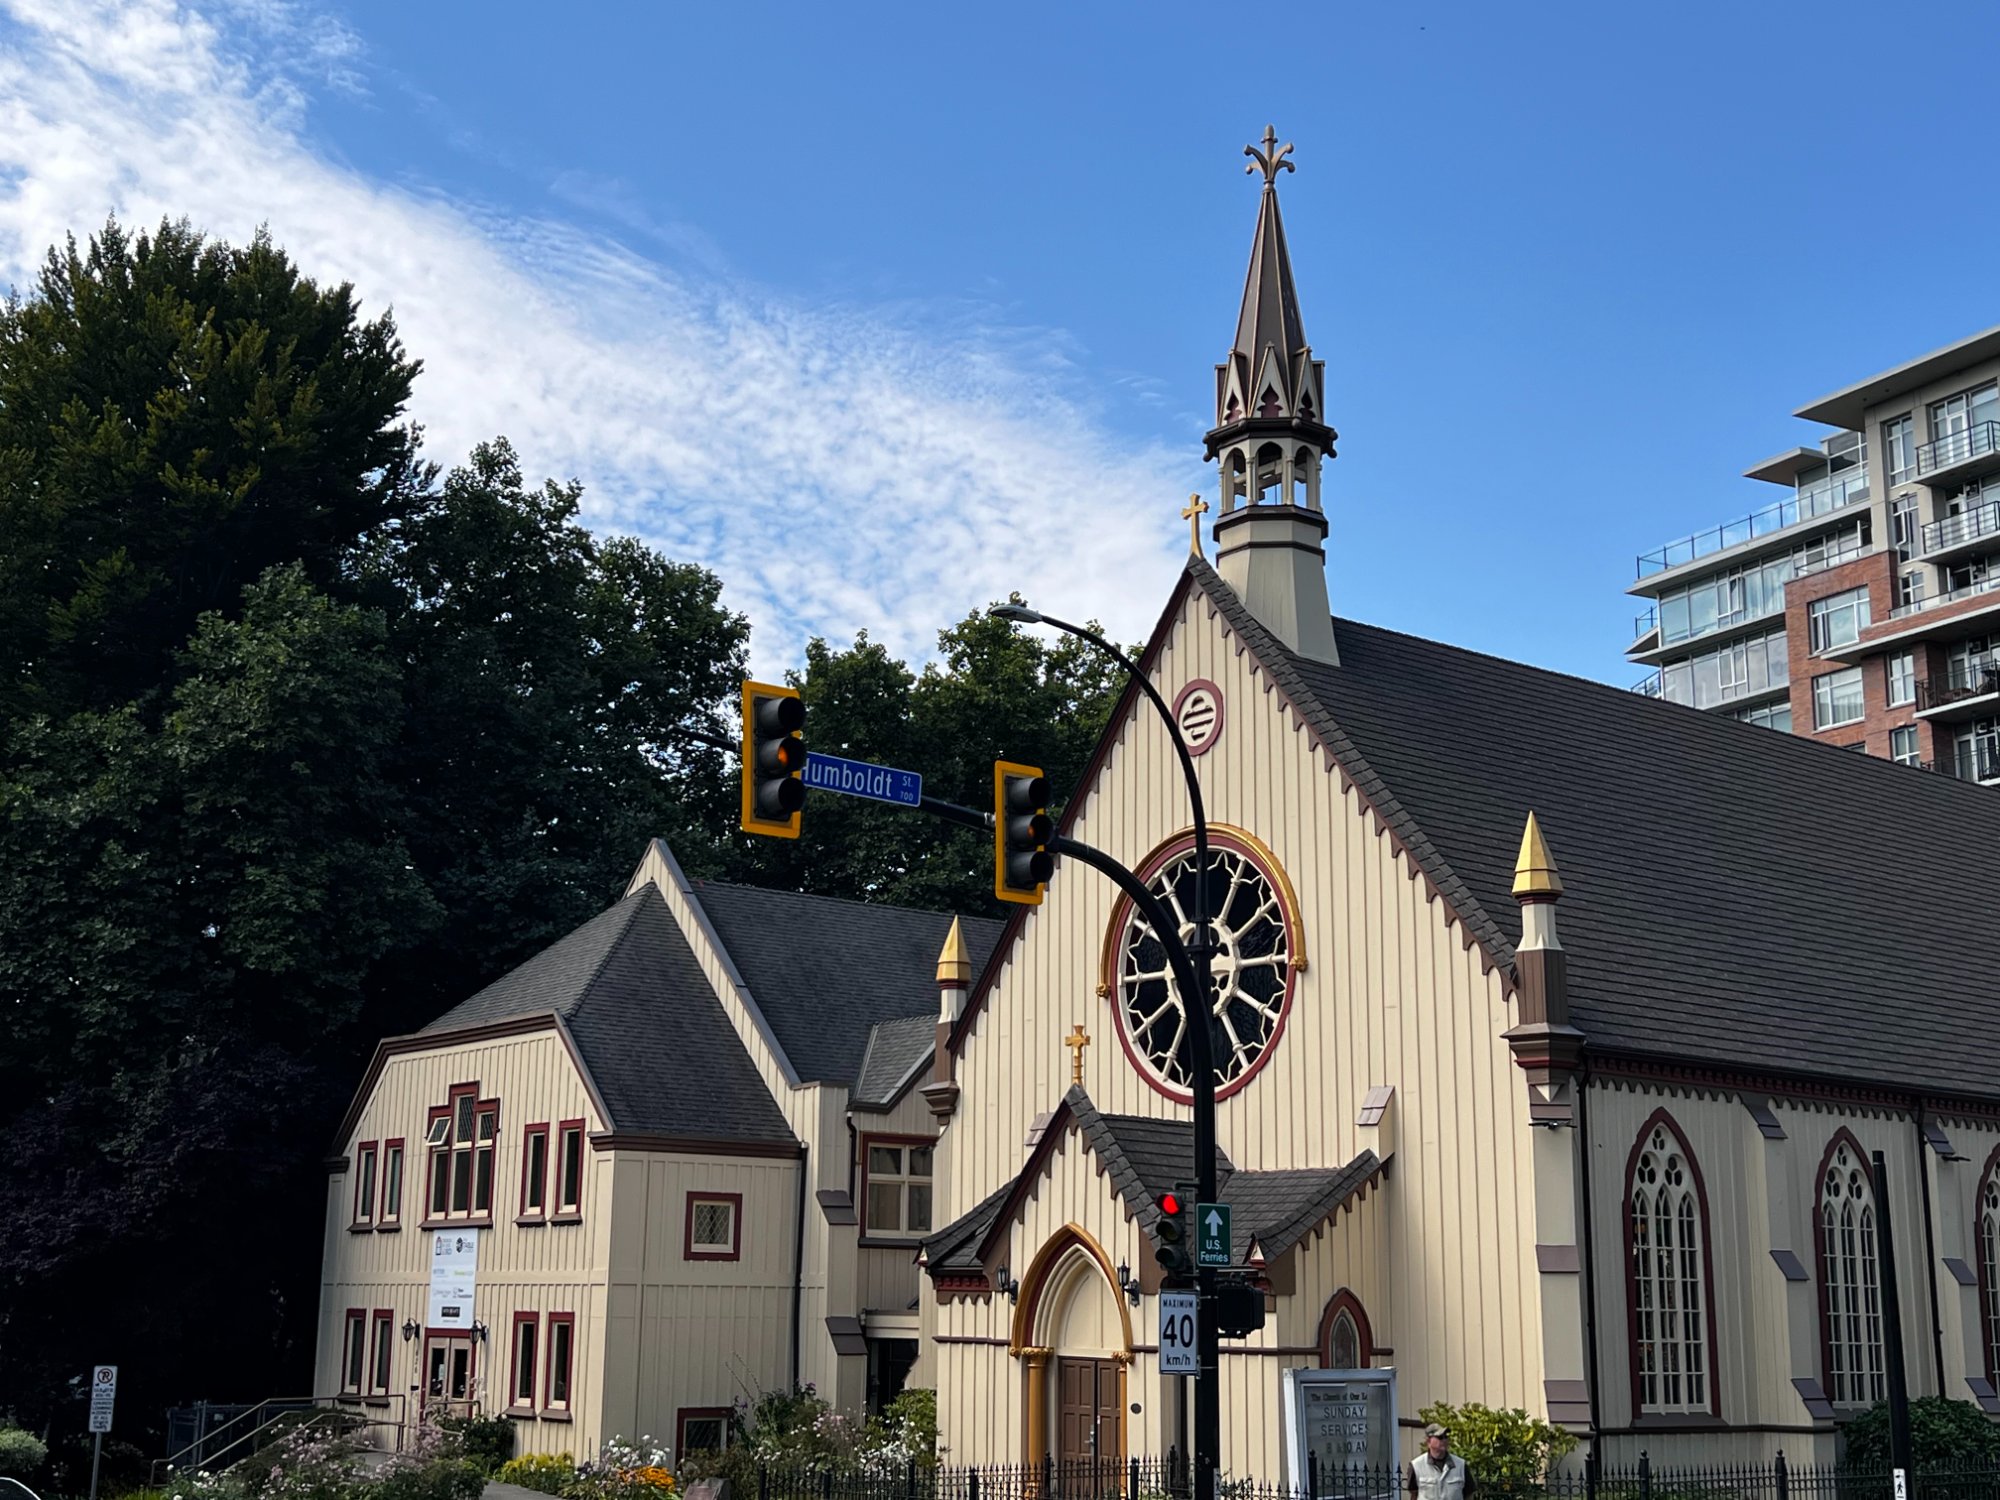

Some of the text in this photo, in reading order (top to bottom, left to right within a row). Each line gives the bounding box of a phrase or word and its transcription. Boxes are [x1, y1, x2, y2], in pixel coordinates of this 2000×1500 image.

[1200, 1251, 1229, 1263] Ferries
[1163, 1299, 1194, 1309] MAXIMUM
[1162, 1314, 1194, 1348] 40
[1166, 1353, 1191, 1366] km/h
[1324, 1406, 1364, 1418] SUNDAY
